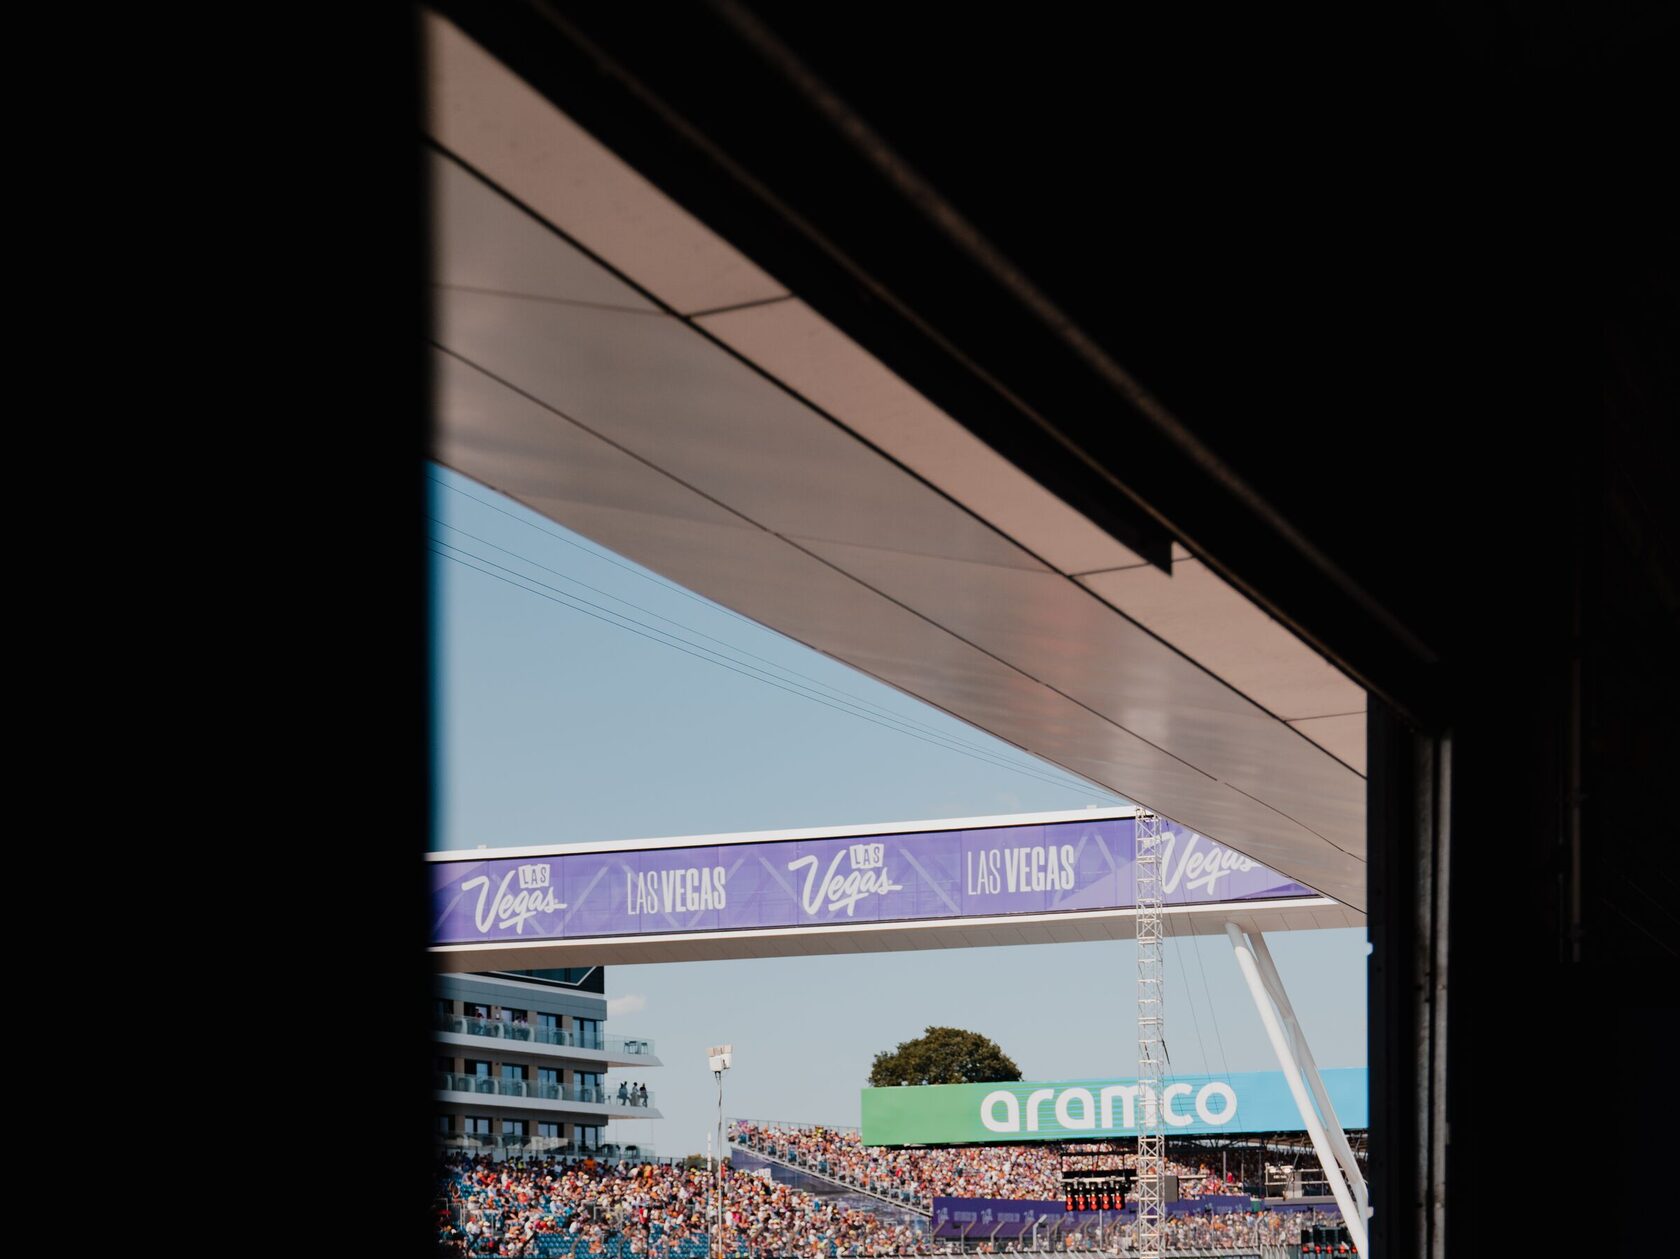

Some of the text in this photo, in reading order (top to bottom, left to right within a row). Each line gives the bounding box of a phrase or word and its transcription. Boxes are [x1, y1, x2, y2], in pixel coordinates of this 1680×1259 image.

[521, 865, 548, 886] LAS
[853, 844, 881, 866] LAS
[967, 844, 1075, 896] LAS VEGAS
[461, 870, 567, 935] Vegas
[626, 866, 726, 916] LAS VEGAS
[788, 849, 903, 917] Vegas
[980, 1081, 1238, 1133] aramco
